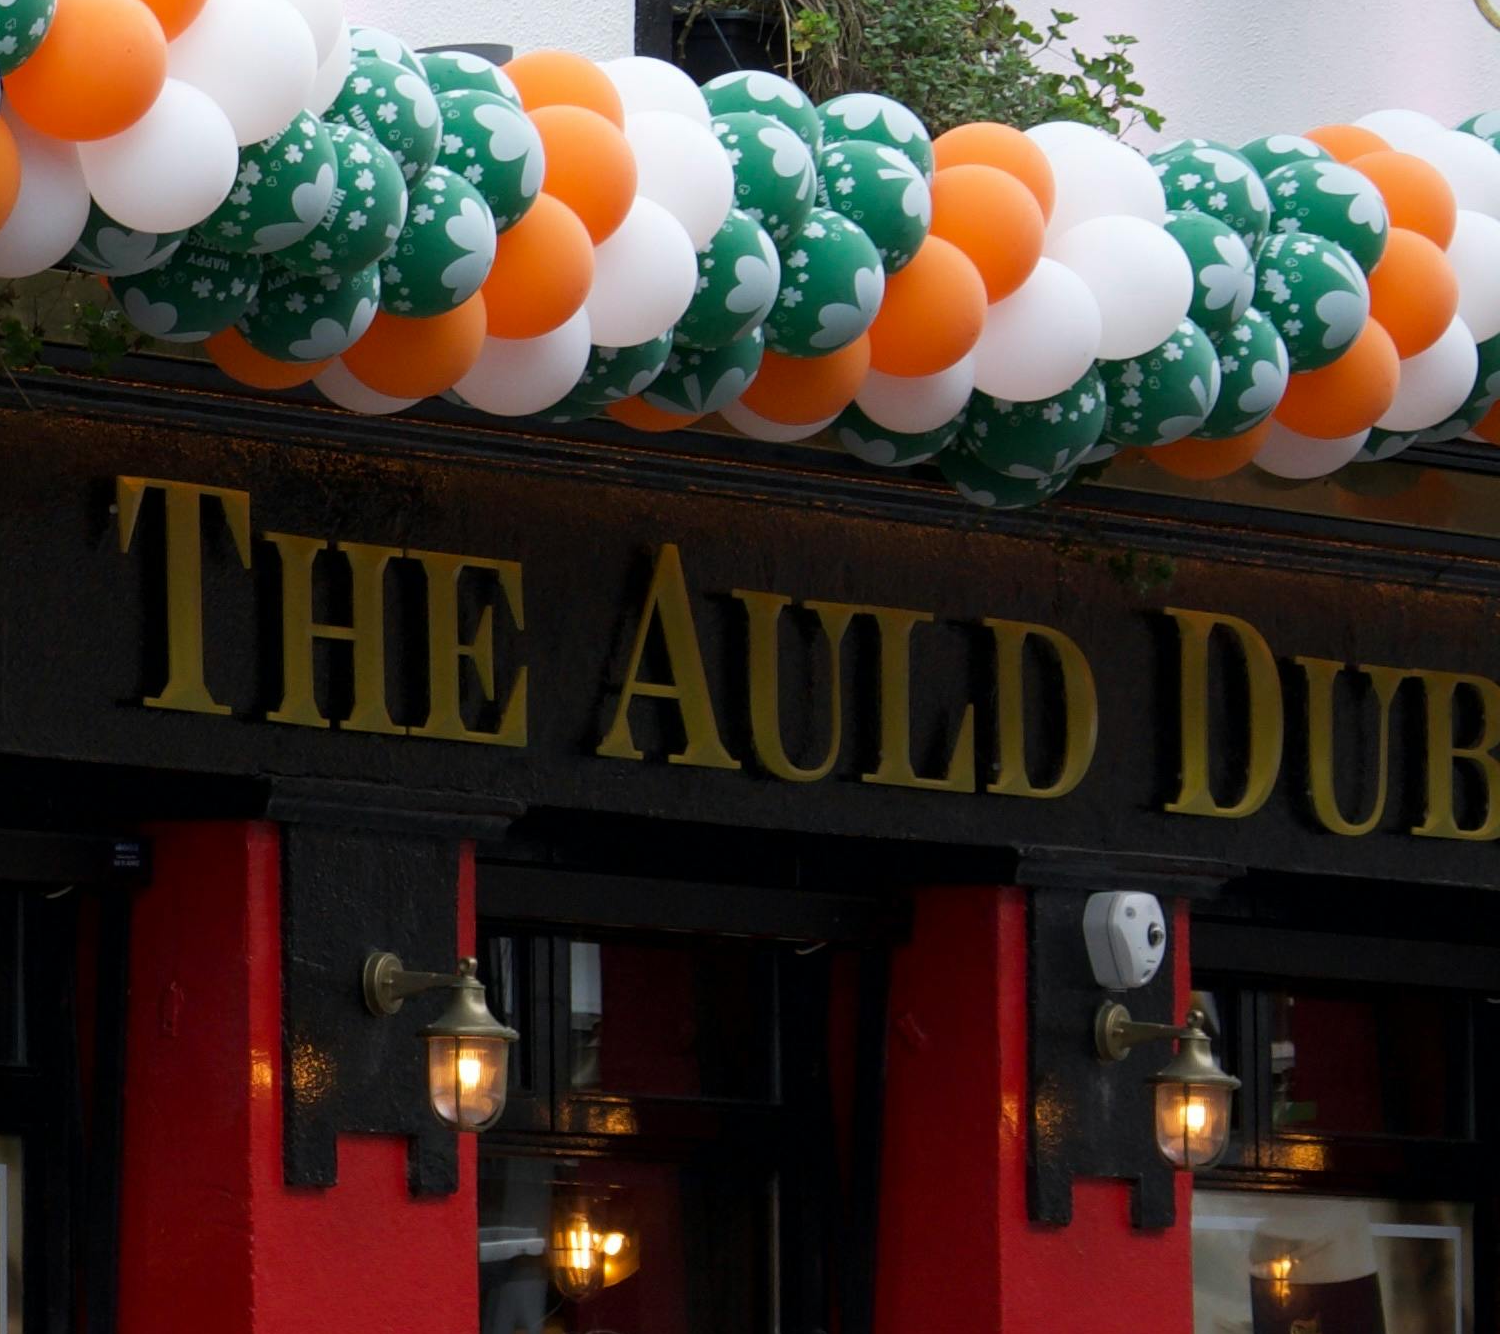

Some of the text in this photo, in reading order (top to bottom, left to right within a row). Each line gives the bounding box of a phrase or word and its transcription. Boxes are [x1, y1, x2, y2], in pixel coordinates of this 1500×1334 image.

[320, 187, 347, 231] HAPPY
[186, 252, 232, 273] HAPPY
[115, 475, 529, 749] THE
[596, 542, 1099, 799] AULD
